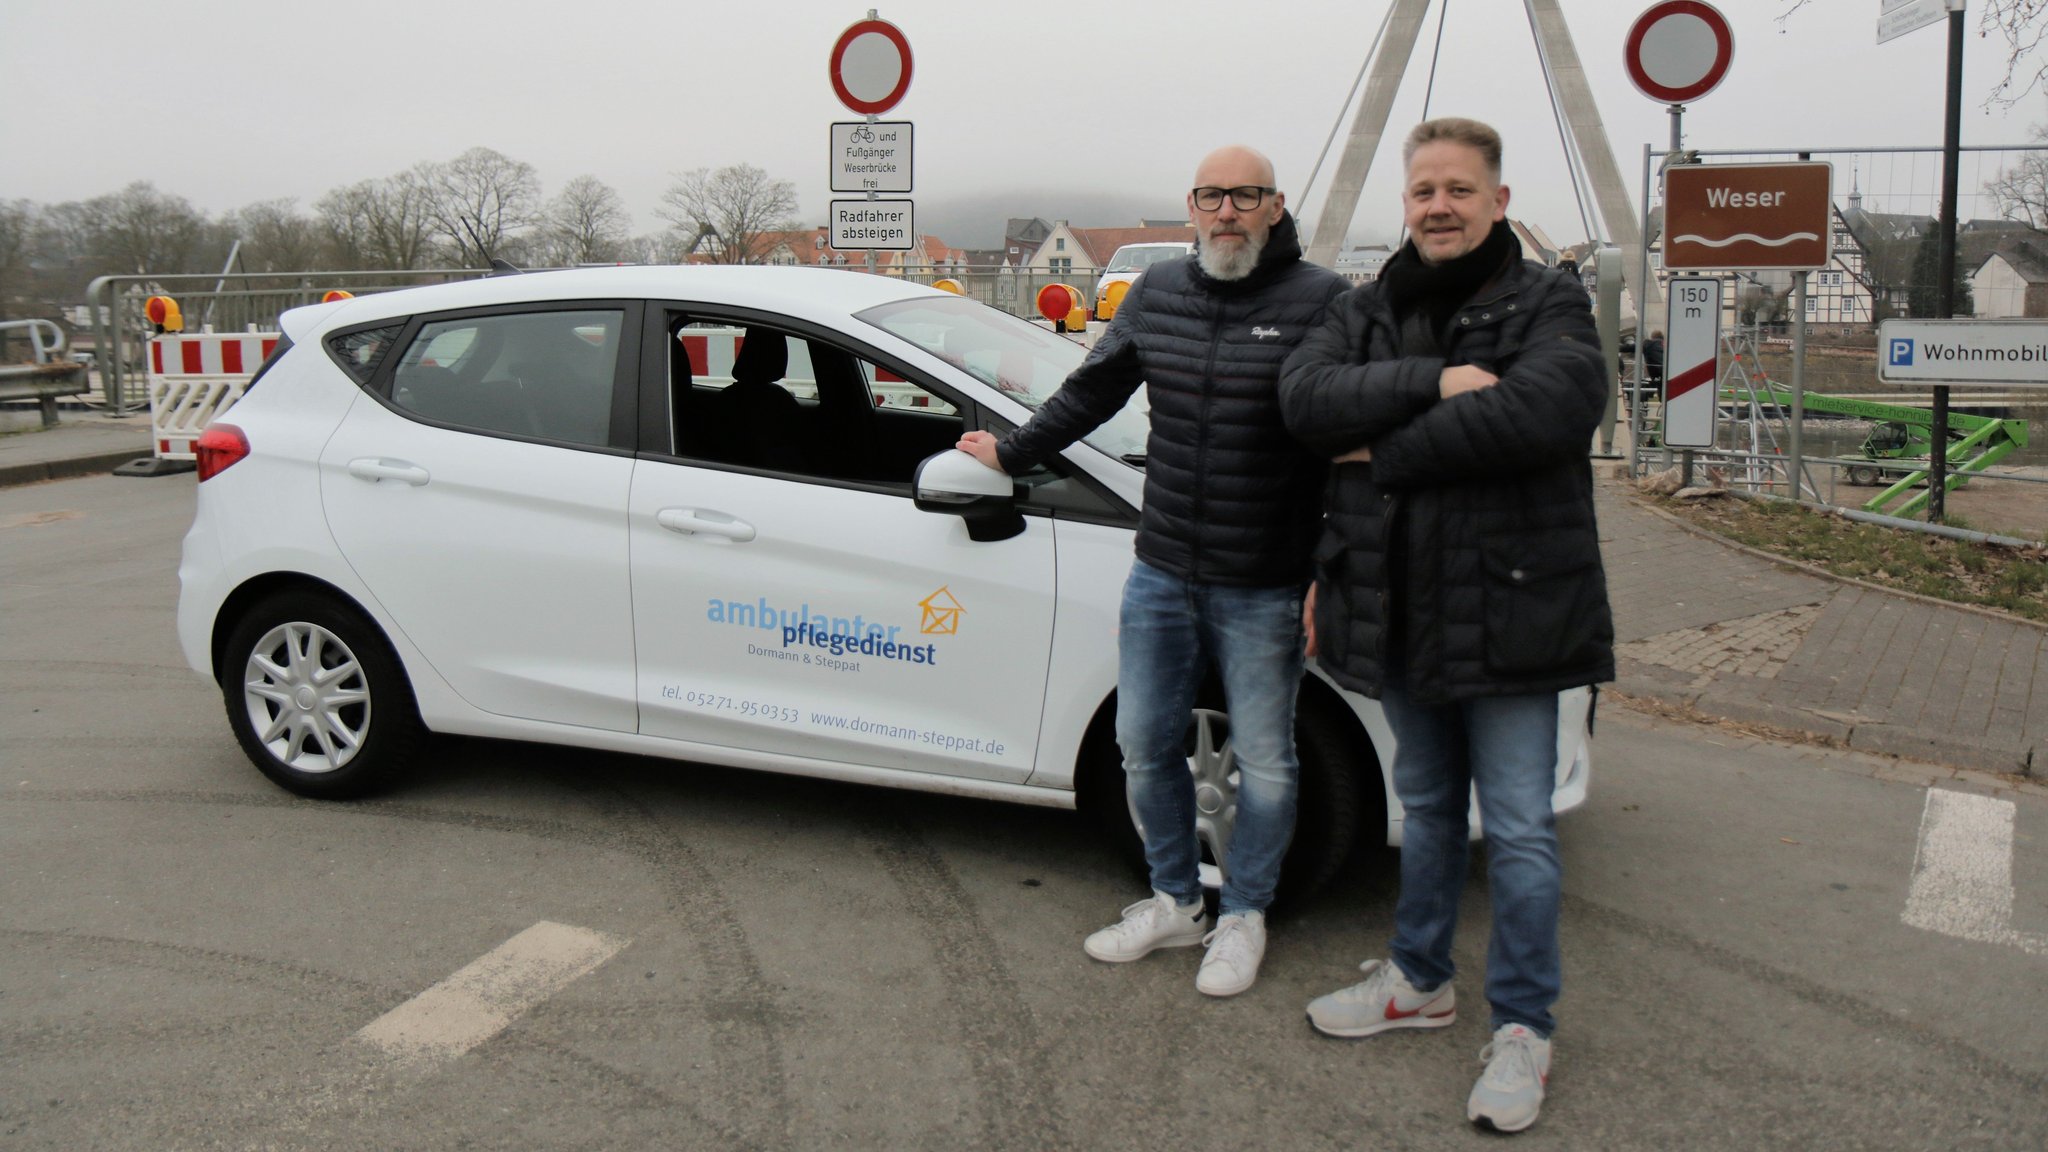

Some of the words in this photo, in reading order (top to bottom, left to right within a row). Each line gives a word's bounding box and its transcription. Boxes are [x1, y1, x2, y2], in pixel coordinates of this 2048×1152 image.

[879, 131, 897, 141] und
[846, 147, 895, 160] Fußgänger
[844, 163, 897, 173] Weserbrücke
[863, 178, 878, 188] frei
[1706, 187, 1786, 208] Weser
[840, 210, 904, 222] Radfahrer
[842, 226, 904, 241] absteigen
[1679, 287, 1708, 303] 150
[1685, 306, 1701, 318] m
[1893, 341, 1910, 363] P
[1924, 344, 2048, 362] Wohnmobil
[1813, 399, 1966, 426] mietservice-hannibde
[707, 597, 901, 646] ambulanter
[783, 622, 936, 665] pflegedienst
[748, 643, 799, 662] Dormann
[803, 653, 811, 664] &
[815, 655, 861, 673] Steppat
[662, 684, 682, 700] tel.
[687, 691, 799, 723] 05271.950353
[811, 712, 1005, 756] www.dormann-steppat.de
